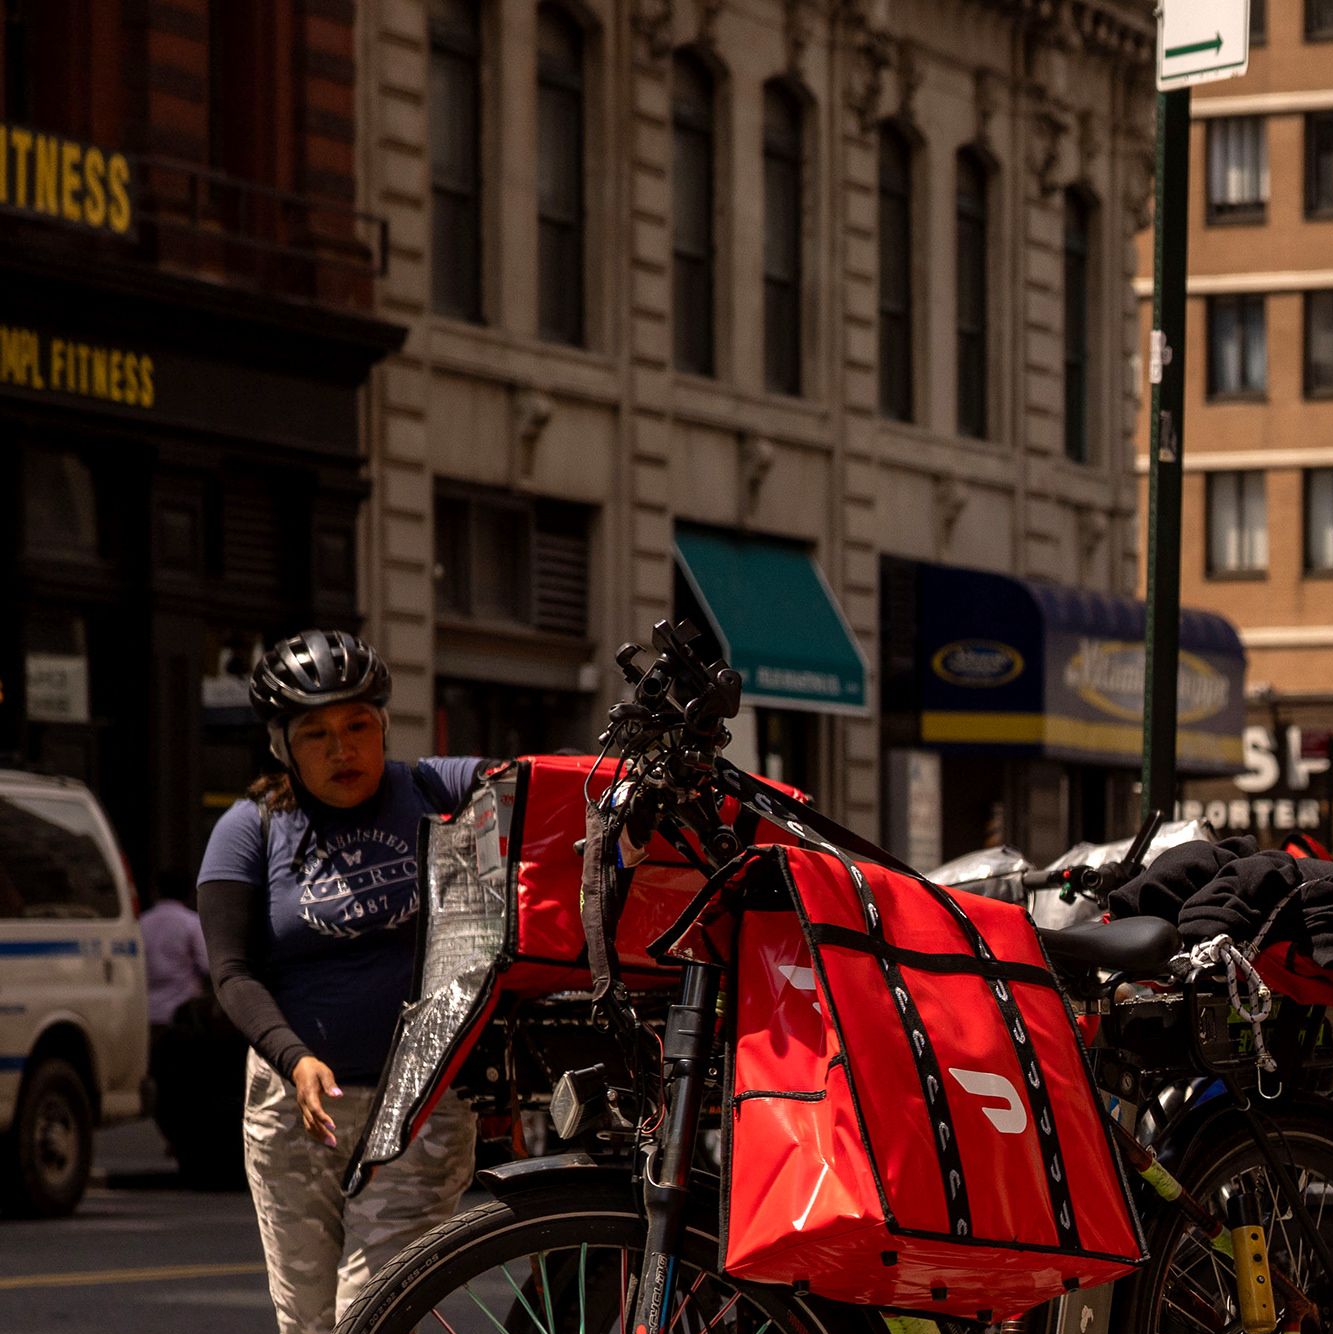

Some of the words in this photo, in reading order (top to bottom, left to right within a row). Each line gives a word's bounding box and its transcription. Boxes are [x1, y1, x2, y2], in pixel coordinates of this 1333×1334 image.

[51, 338, 155, 408] FITNESS
[1174, 799, 1320, 830] PORTER
[342, 895, 389, 921] 1987
